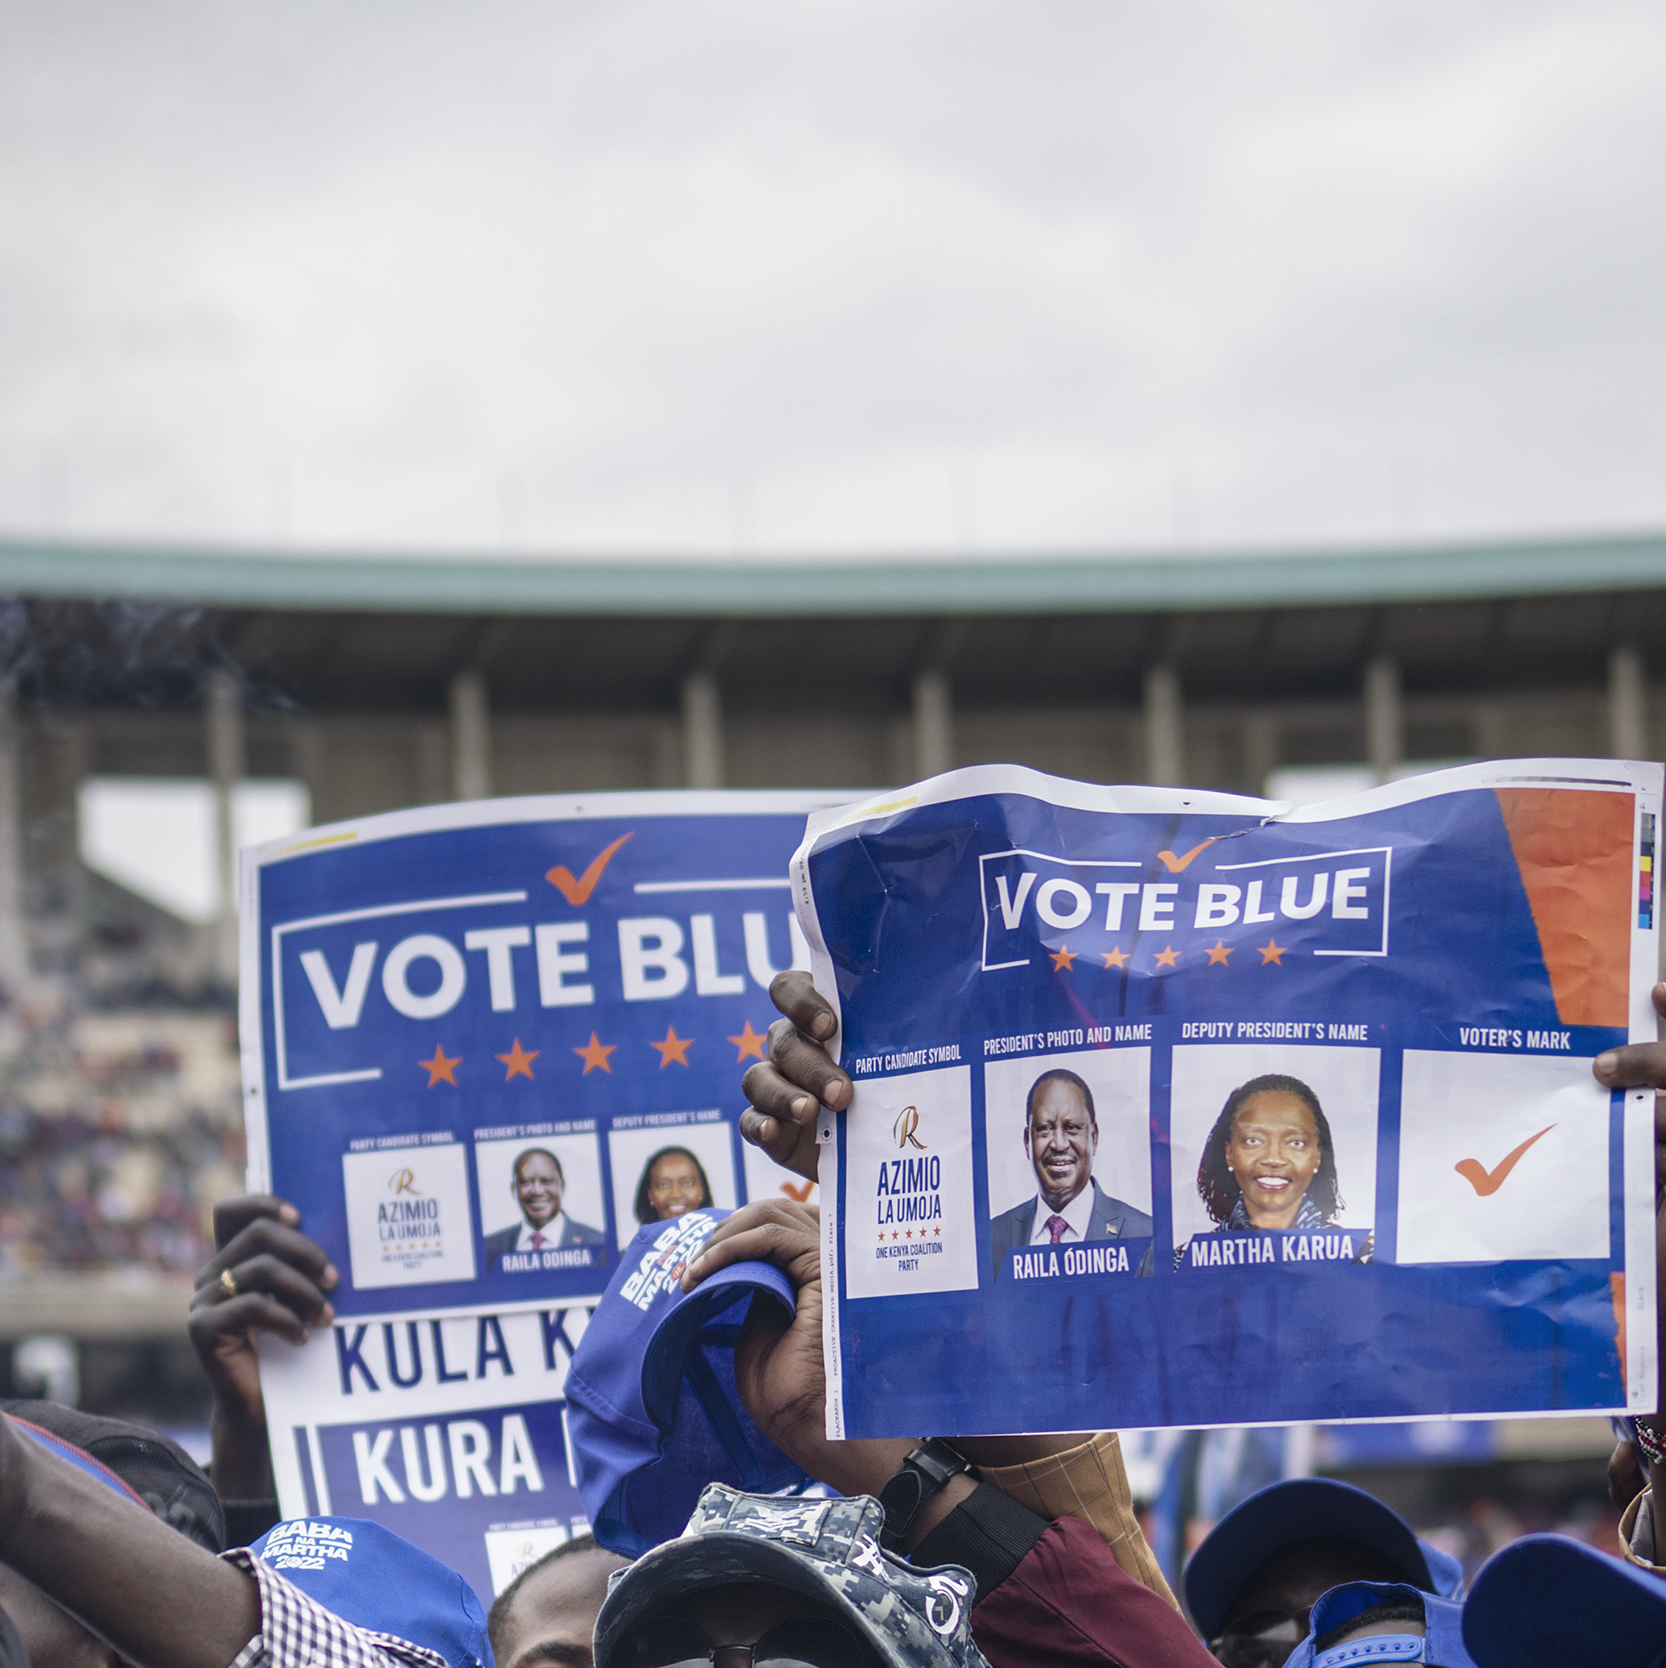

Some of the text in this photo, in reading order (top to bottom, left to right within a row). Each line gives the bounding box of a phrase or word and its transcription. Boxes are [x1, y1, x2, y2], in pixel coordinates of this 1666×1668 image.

[994, 867, 1372, 931] VOTE BLUE
[299, 911, 811, 1031] VOTE BLU
[983, 1024, 1153, 1056] PRESIDENT'S PHOTO AND NAME
[1182, 1022, 1369, 1041] DEPUTY PRESIDENT'S NAME
[1459, 1027, 1572, 1051] VOTER'S MARK
[855, 1044, 963, 1074] PARTY CANDIDATE SYMBOL
[526, 1123, 553, 1136] PHOTO
[552, 1121, 570, 1134] AND
[570, 1119, 597, 1132] NAME
[613, 1115, 643, 1128] DEPUTY
[696, 1109, 722, 1122] NAME
[350, 1129, 454, 1151] PARTY CANDIDATE SYMBOL
[877, 1155, 941, 1198] AZIMIO
[378, 1198, 439, 1224] AZIMIO
[878, 1194, 942, 1225] LA UMOJA
[396, 1221, 442, 1240] UMOJA
[502, 1252, 540, 1273] RAILA
[619, 1211, 708, 1302] BABA
[875, 1241, 943, 1260] ONE KENYA COALITION
[1191, 1234, 1354, 1267] MARTHA KARUA
[636, 1220, 719, 1312] MARTHA
[897, 1258, 920, 1272] PARTY
[1013, 1250, 1060, 1280] RAILA
[335, 1315, 515, 1396] KULA
[353, 1413, 543, 1505] KURA
[266, 1520, 354, 1546] BABA
[259, 1543, 349, 1562] MARTHA
